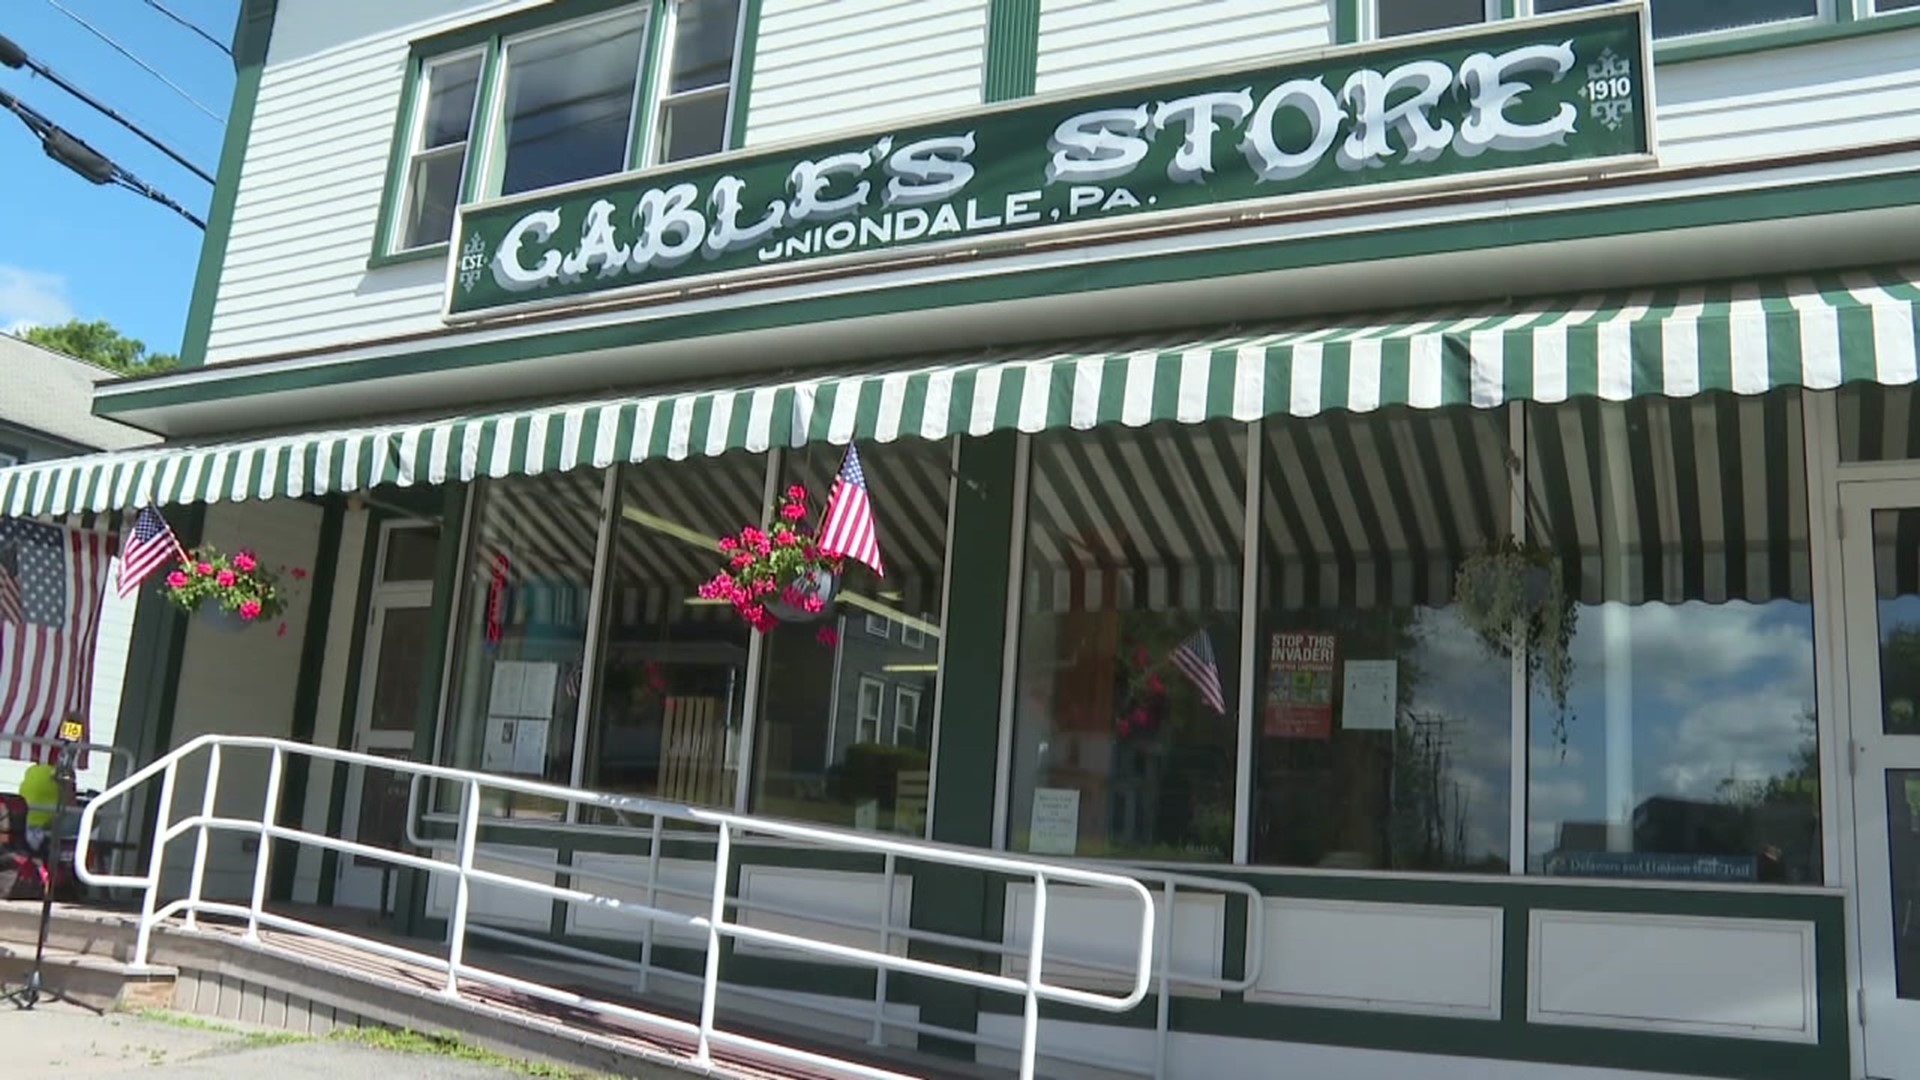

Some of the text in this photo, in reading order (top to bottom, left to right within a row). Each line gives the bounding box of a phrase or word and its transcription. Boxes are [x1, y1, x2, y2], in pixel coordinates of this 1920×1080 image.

[1587, 76, 1631, 101] 1910
[493, 38, 1578, 290] CABLE'S STORE
[1271, 633, 1335, 649] STOP THIS
[1271, 648, 1334, 663] INVADER!
